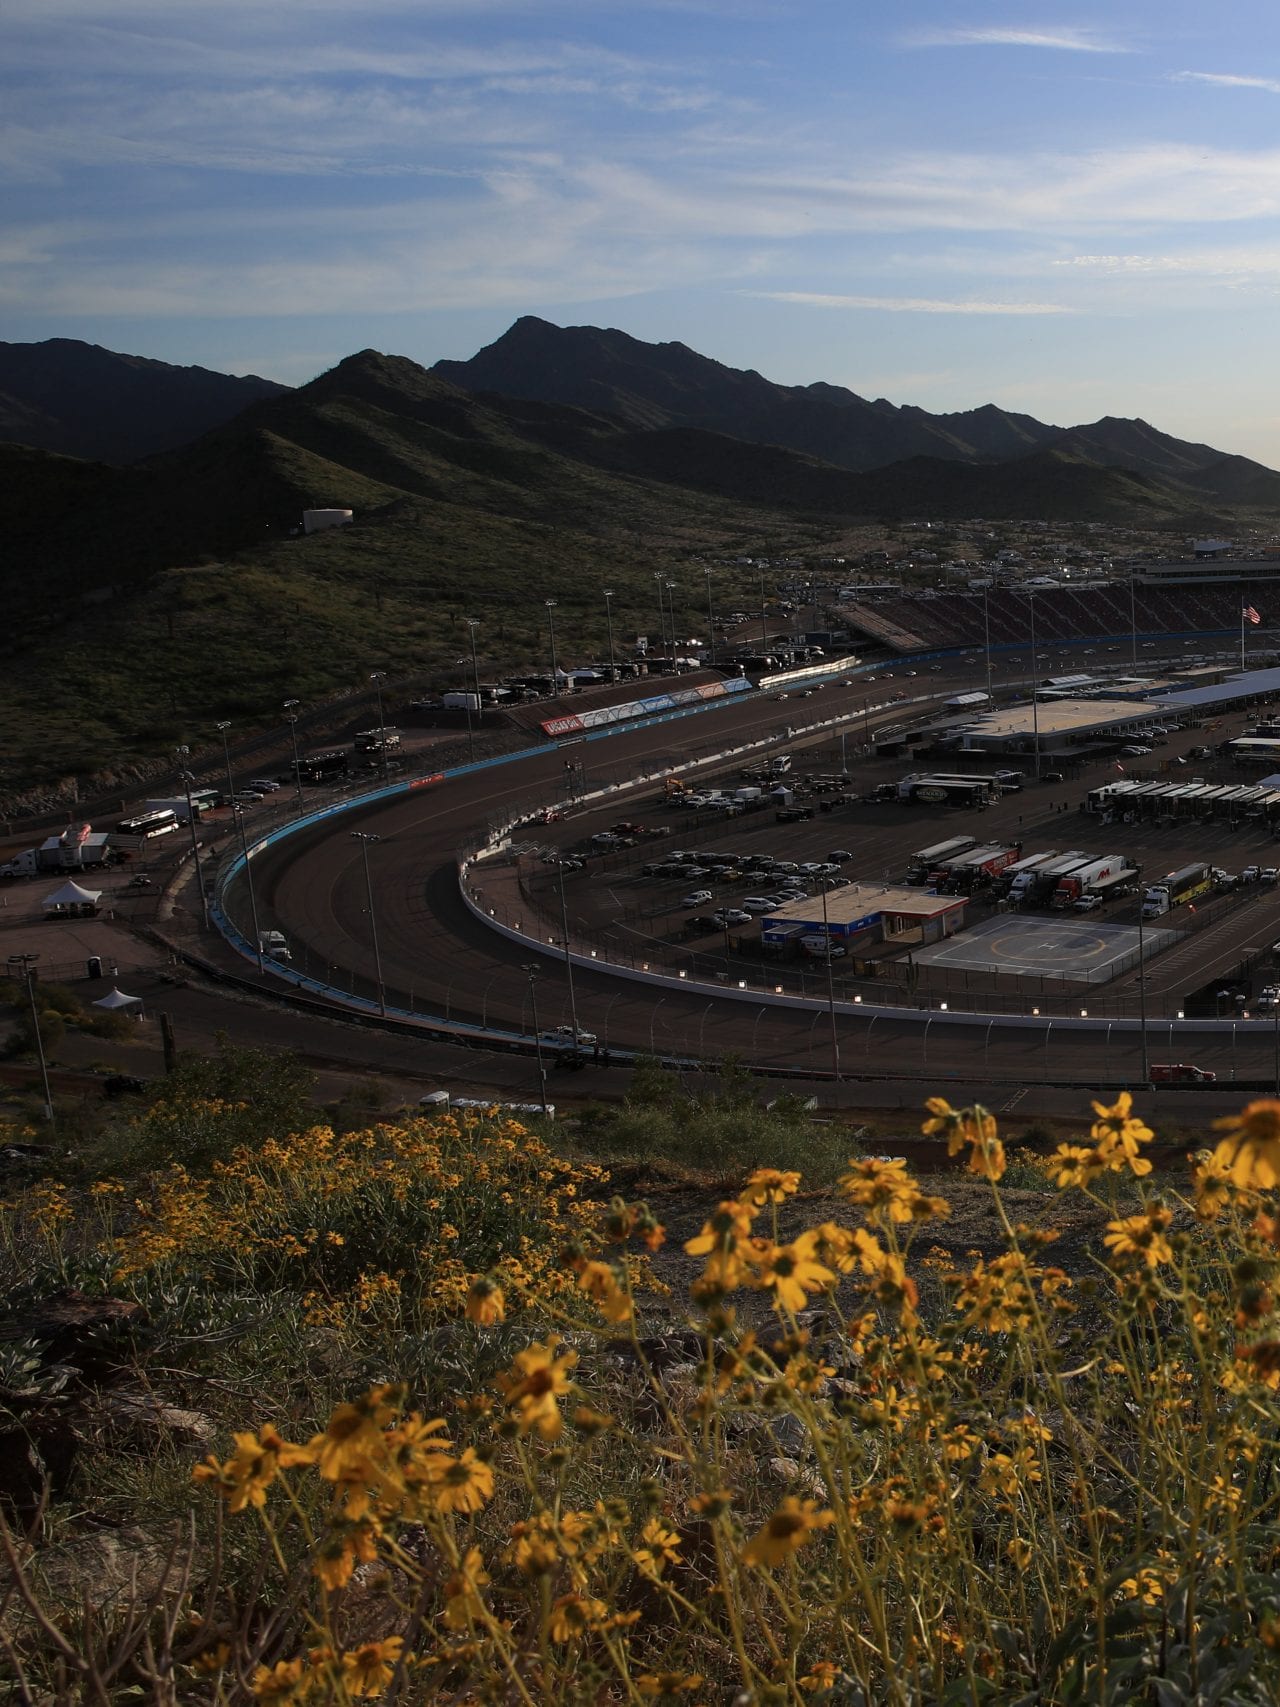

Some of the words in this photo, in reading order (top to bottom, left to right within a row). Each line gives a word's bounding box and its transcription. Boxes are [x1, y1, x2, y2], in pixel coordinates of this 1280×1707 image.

[546, 720, 568, 732] LUCAS
[567, 718, 579, 728] OIL
[1037, 942, 1060, 950] H
